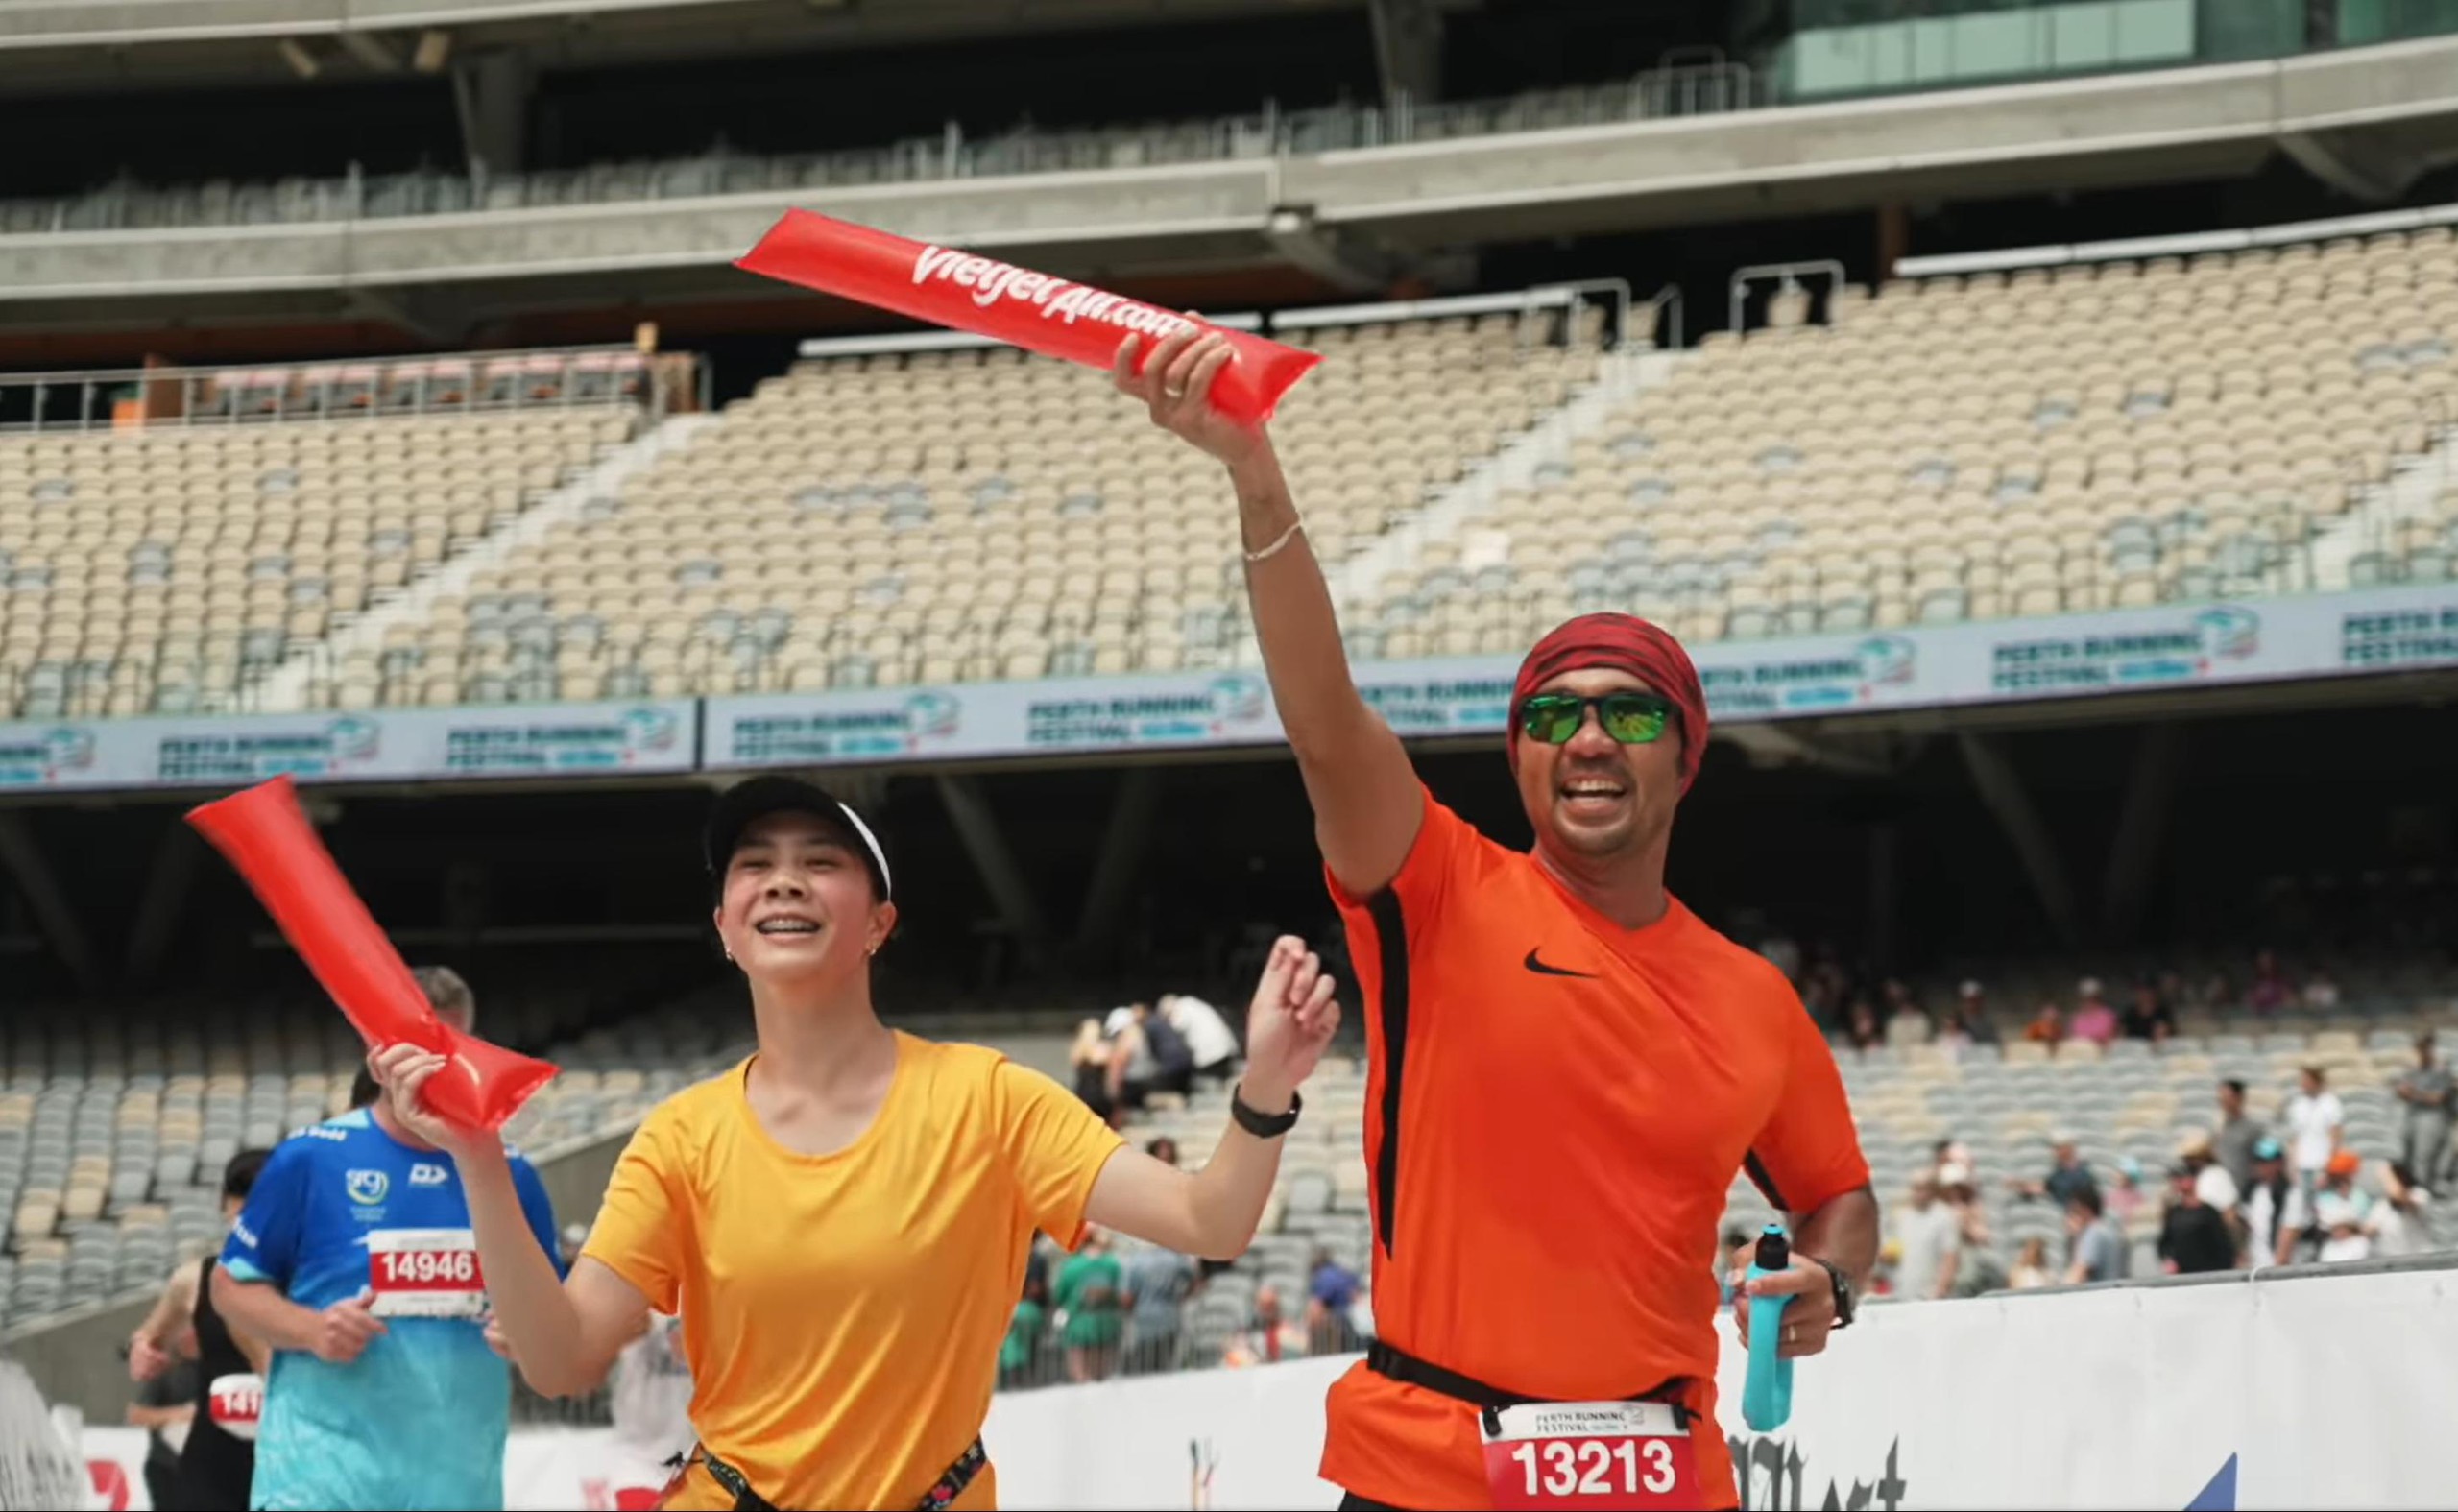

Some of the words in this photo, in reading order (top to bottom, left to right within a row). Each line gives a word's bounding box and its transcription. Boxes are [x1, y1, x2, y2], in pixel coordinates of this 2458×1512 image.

[380, 1251, 474, 1283] 14946
[1535, 1412, 1573, 1423] PERTH
[1575, 1411, 1626, 1422] RUNNING
[1536, 1423, 1590, 1433] FESTIVAL
[1511, 1439, 1677, 1497] 13213
